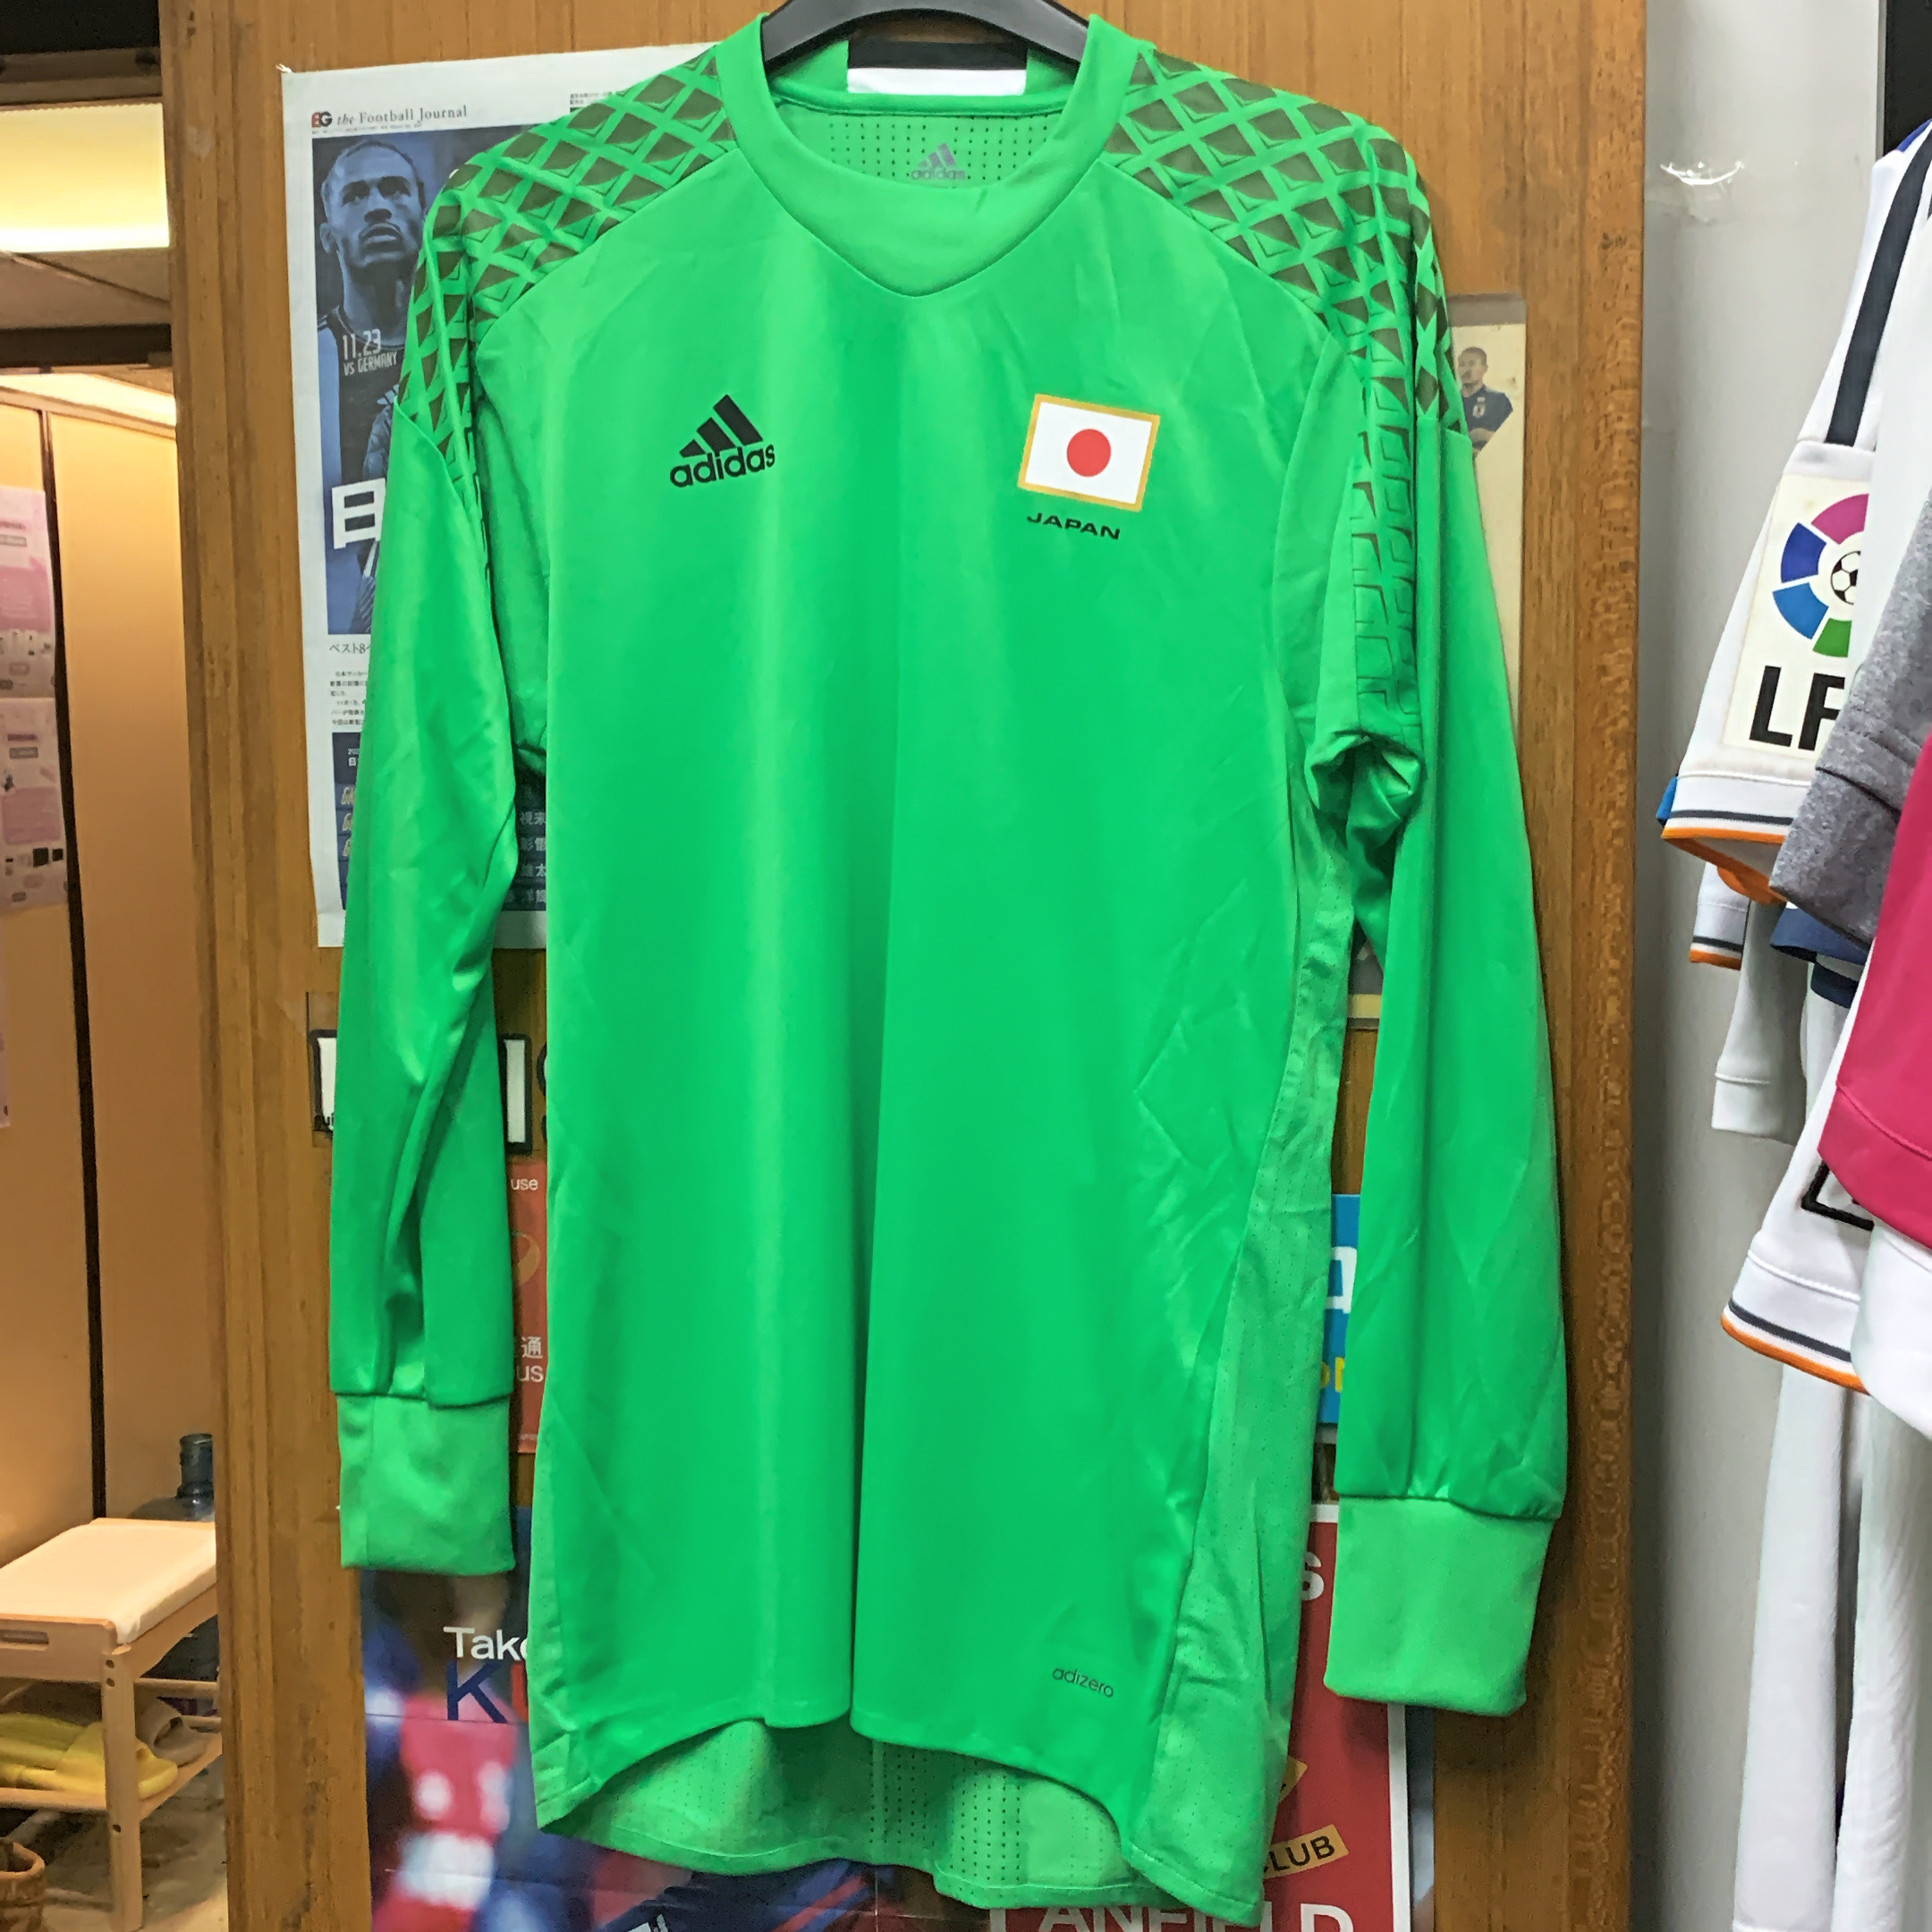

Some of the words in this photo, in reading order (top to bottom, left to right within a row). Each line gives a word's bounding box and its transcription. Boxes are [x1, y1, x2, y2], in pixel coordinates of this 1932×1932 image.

[336, 113, 354, 125] the
[359, 108, 414, 124] Football
[418, 105, 468, 123] Journal
[343, 328, 382, 360] 11.23
[343, 361, 355, 376] VS
[358, 350, 398, 373] GERMANY
[669, 444, 775, 488] adidas
[1027, 513, 1121, 540] JAPAN
[1052, 1668, 1114, 1698] adizero
[1264, 1835, 1335, 1873] LUB
